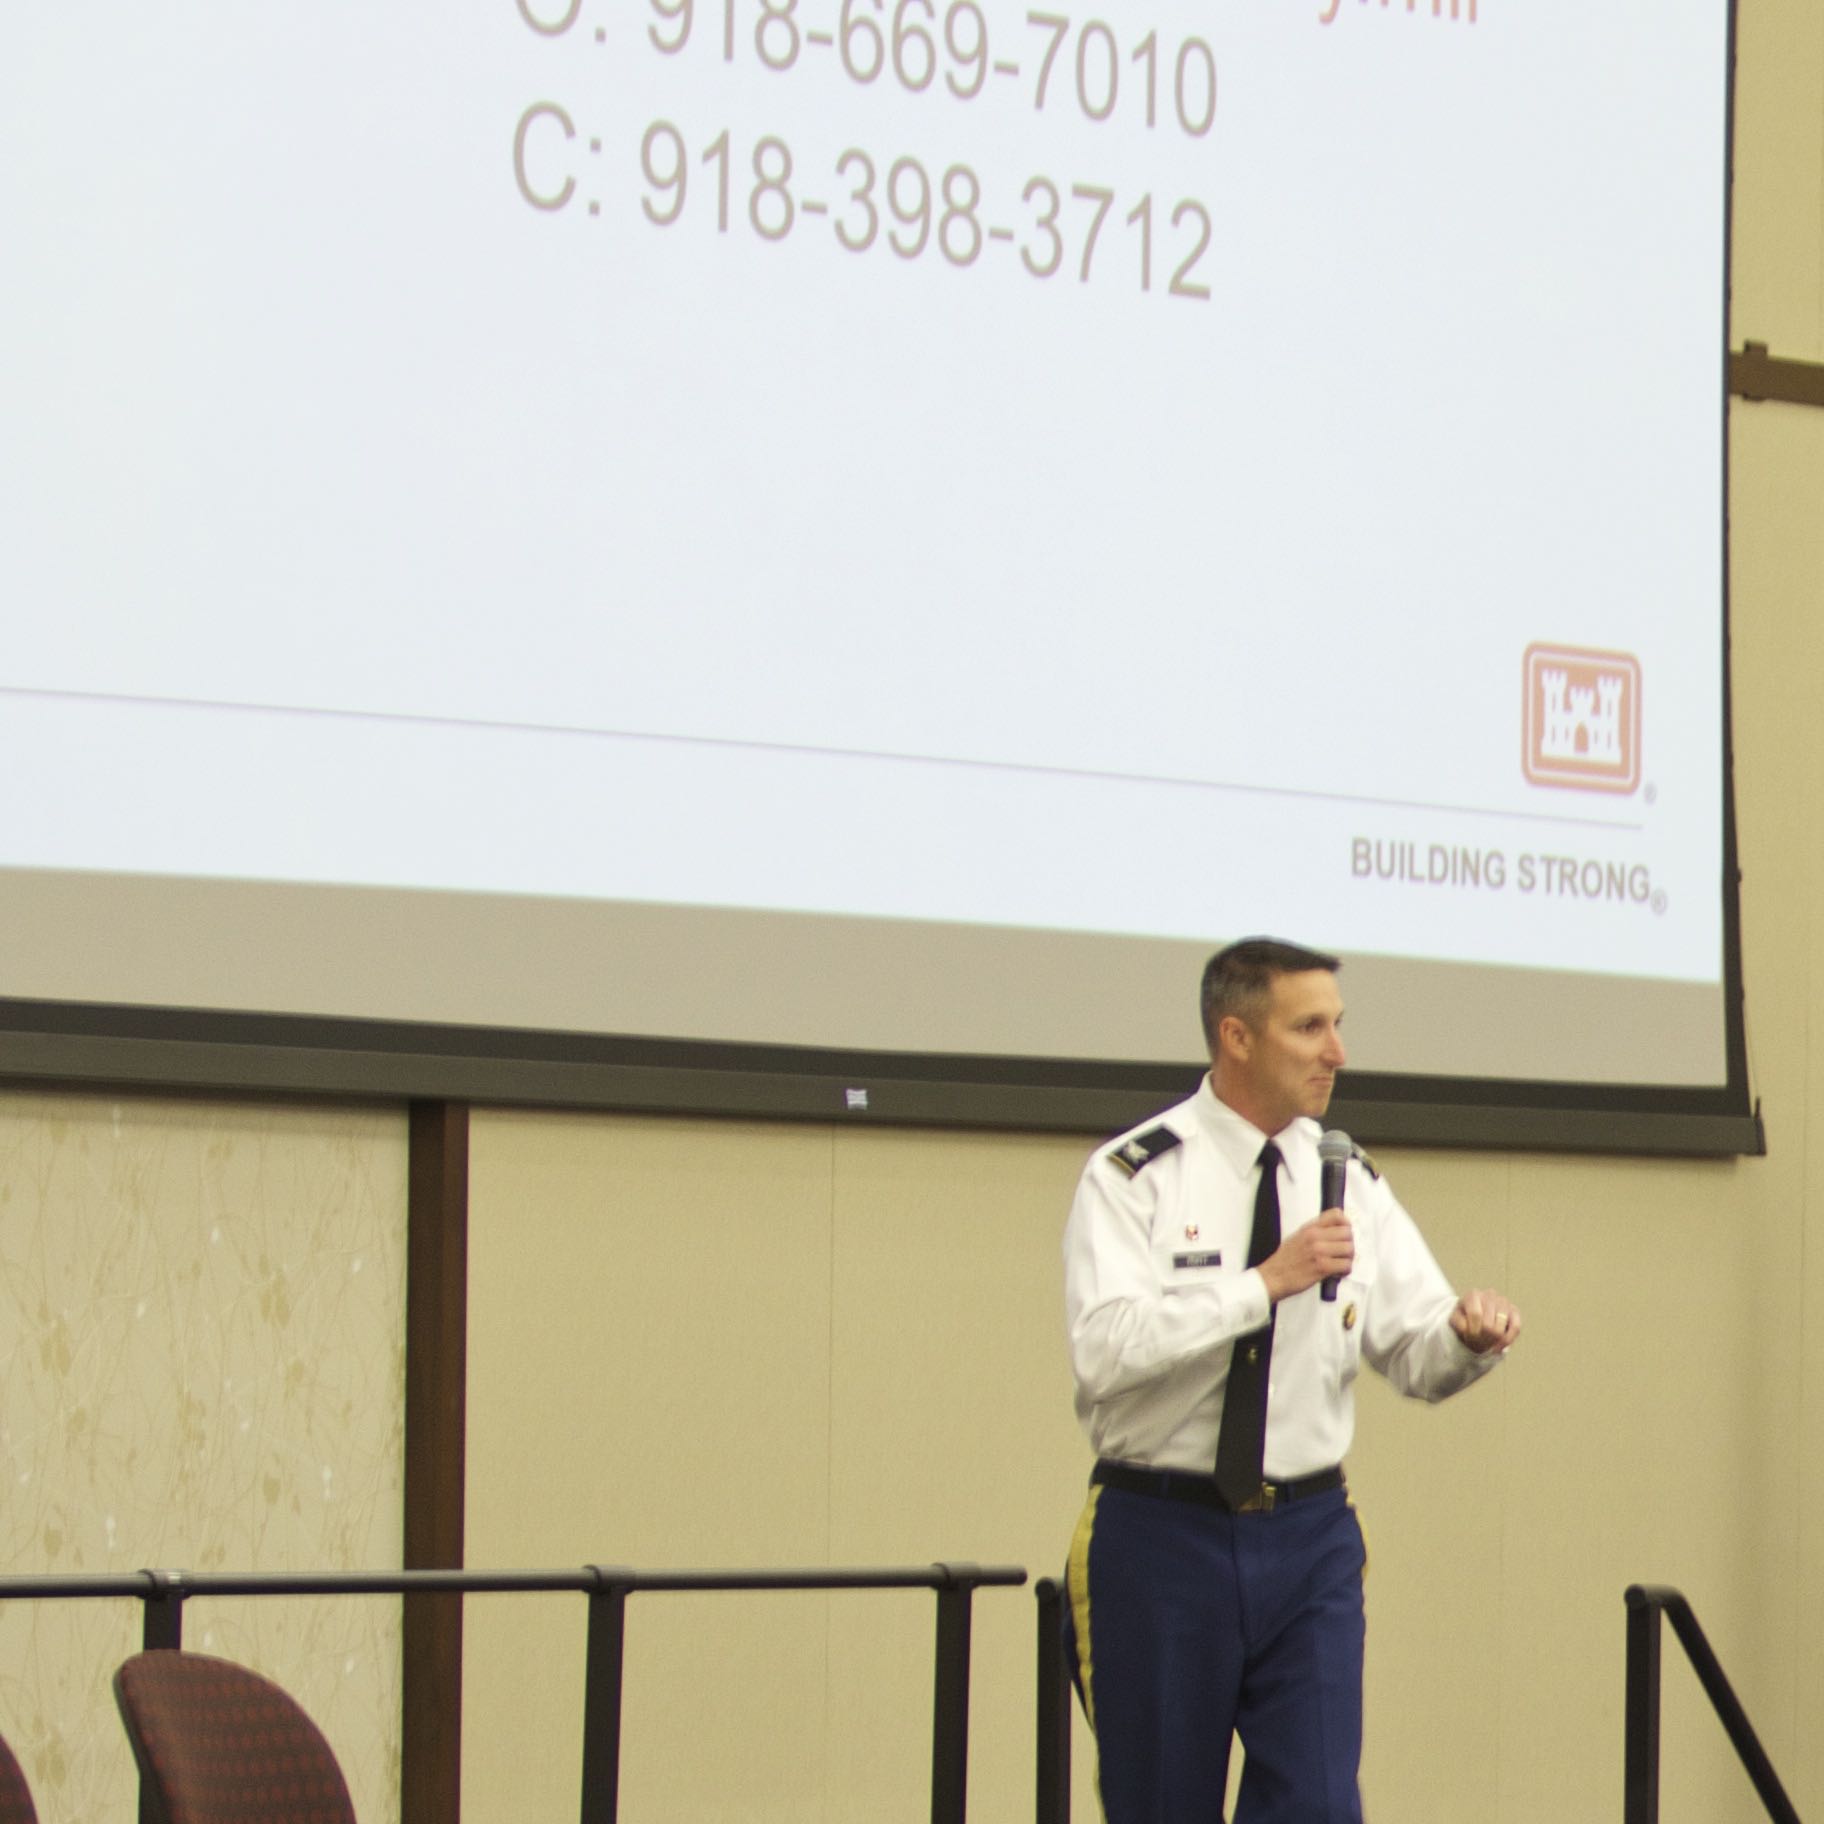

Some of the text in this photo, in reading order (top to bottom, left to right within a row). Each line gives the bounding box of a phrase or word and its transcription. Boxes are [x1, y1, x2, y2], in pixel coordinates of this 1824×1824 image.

[647, 0, 1217, 139] 918-669-7010
[512, 100, 1212, 301] C: 918-398-3712
[1351, 836, 1506, 890] BUILDING
